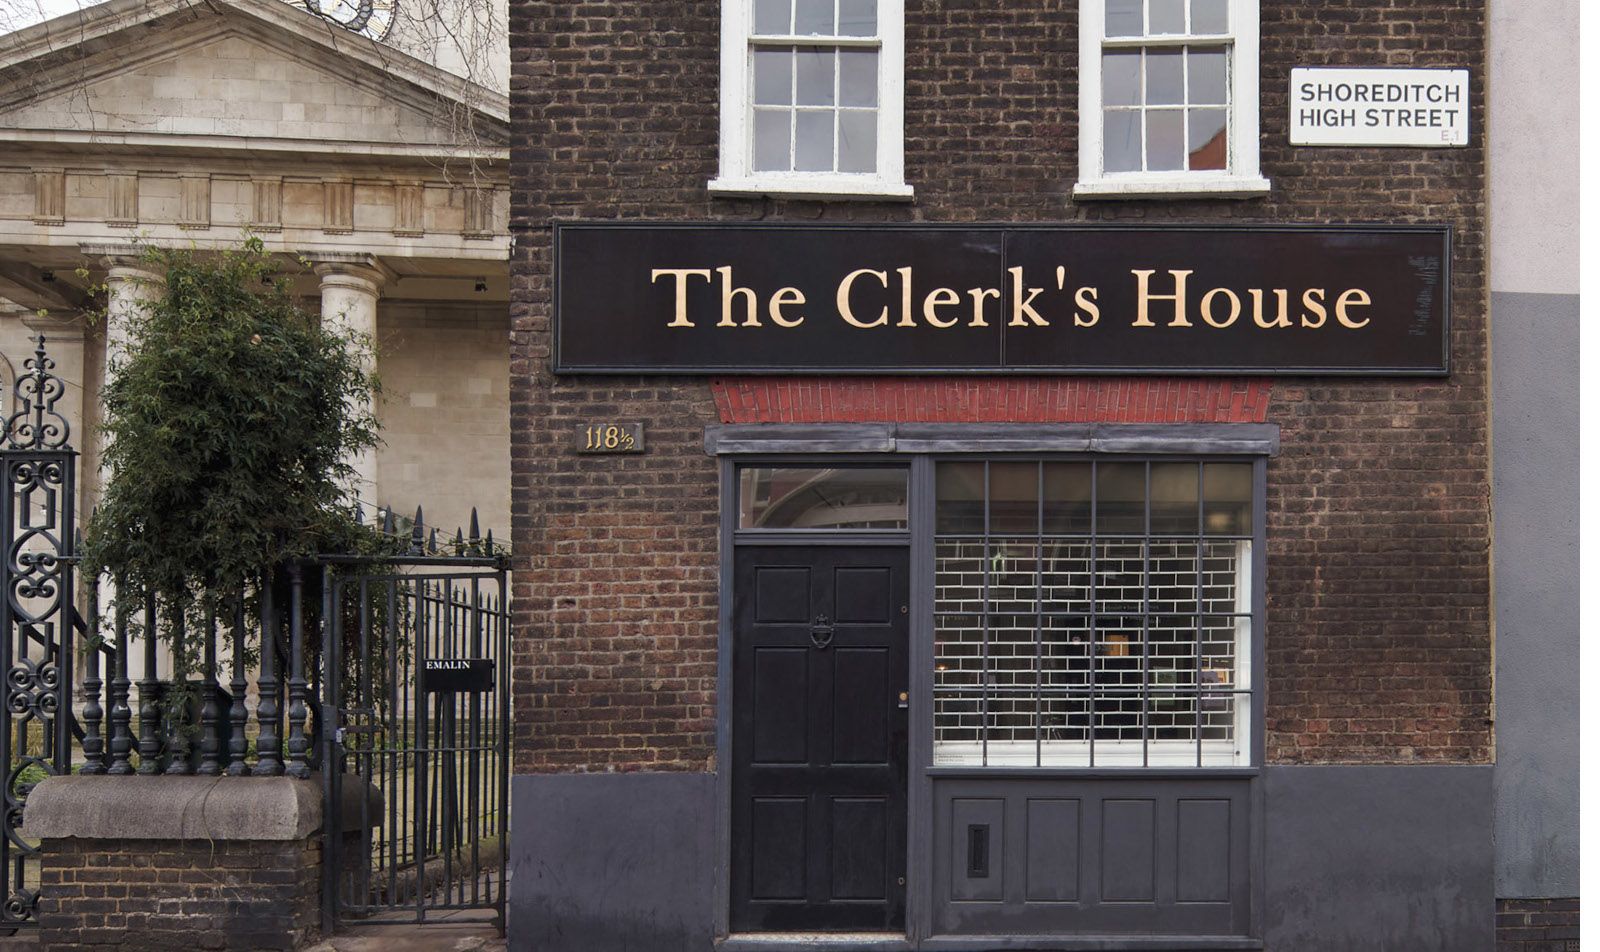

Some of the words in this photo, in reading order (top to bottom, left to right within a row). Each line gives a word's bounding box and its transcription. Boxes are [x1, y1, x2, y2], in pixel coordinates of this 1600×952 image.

[1301, 83, 1459, 102] SHOREDITCH
[1300, 109, 1356, 127] HIGH
[1365, 109, 1458, 127] STREET
[651, 265, 807, 328] The
[836, 265, 1101, 329] Clerk's
[1130, 269, 1372, 329] House
[426, 661, 470, 669] EMALIN
